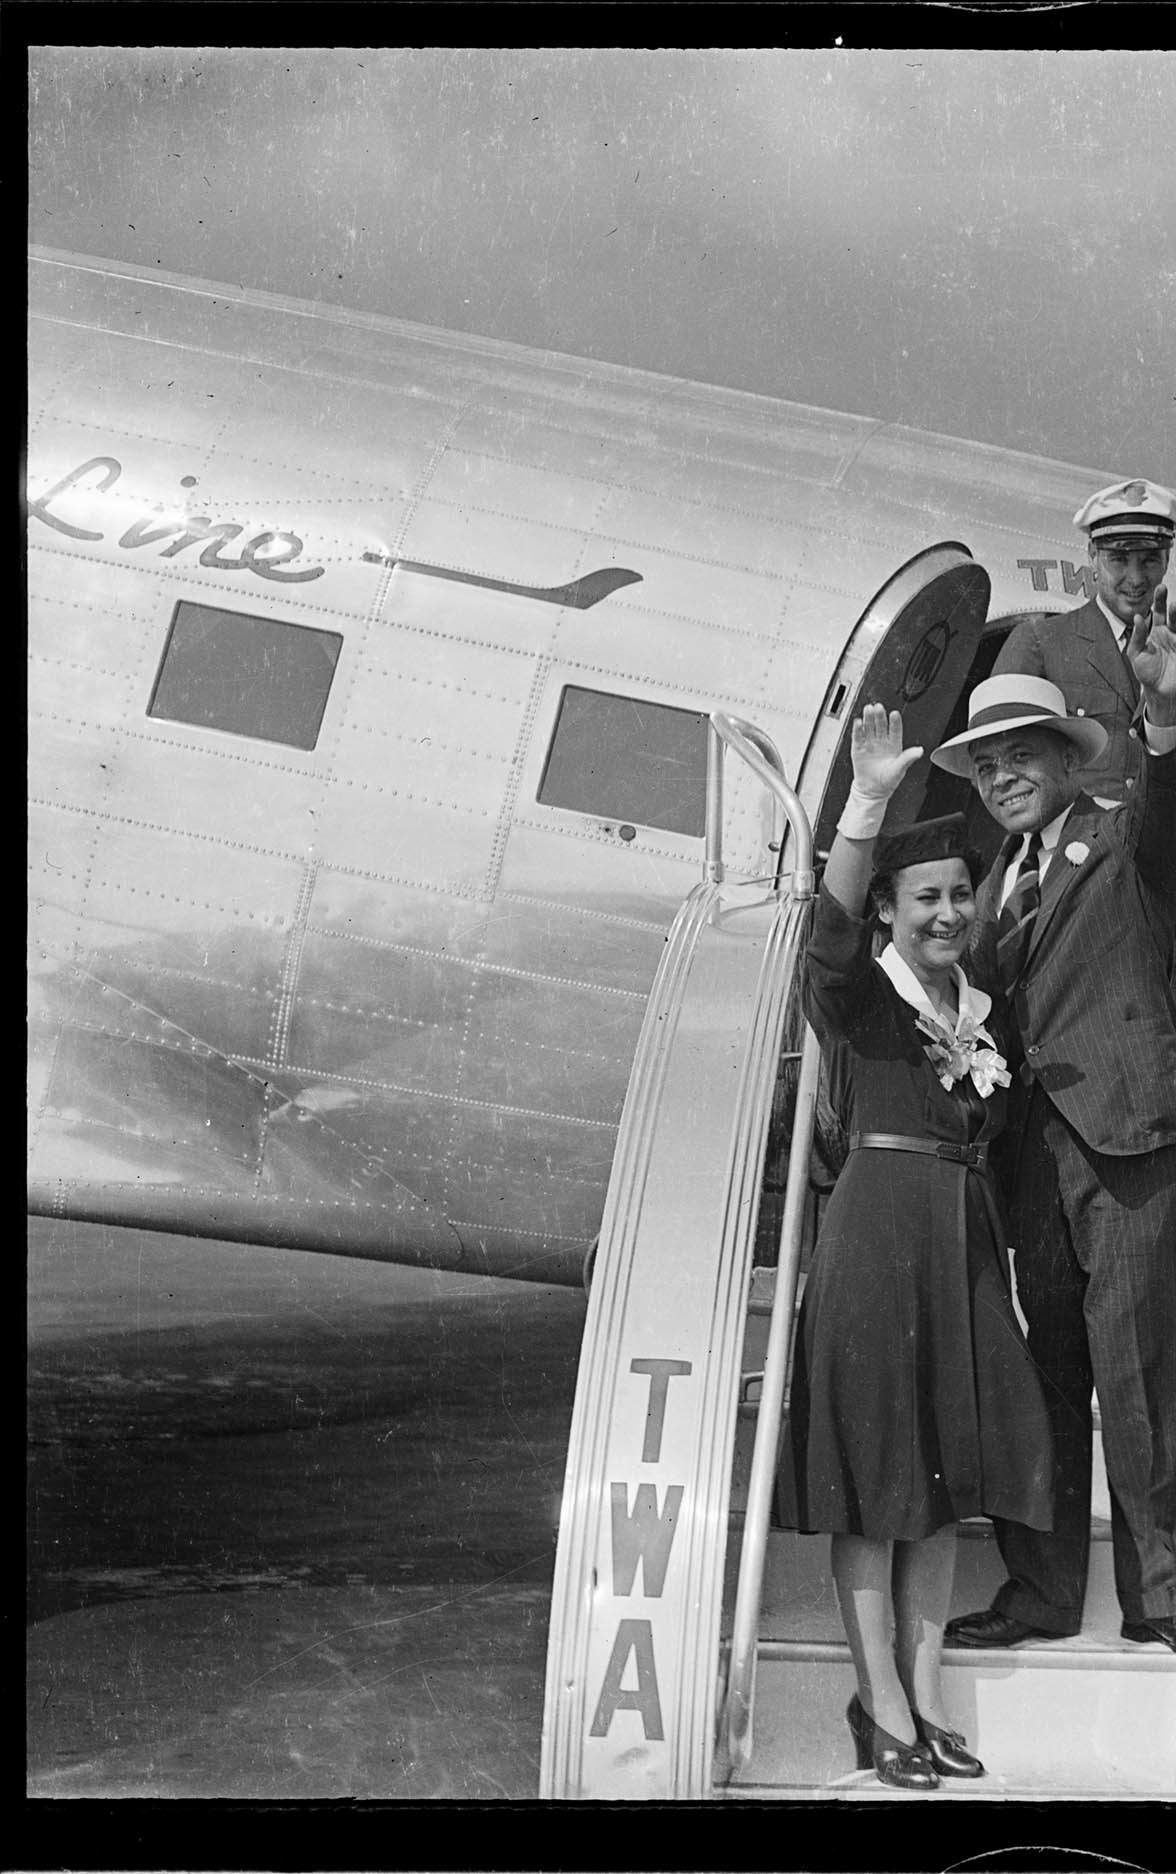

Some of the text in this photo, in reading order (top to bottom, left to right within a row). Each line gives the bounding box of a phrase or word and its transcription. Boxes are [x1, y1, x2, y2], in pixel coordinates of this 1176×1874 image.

[28, 456, 325, 583] Line
[1016, 559, 1099, 601] TW
[589, 1358, 693, 1741] TWA
